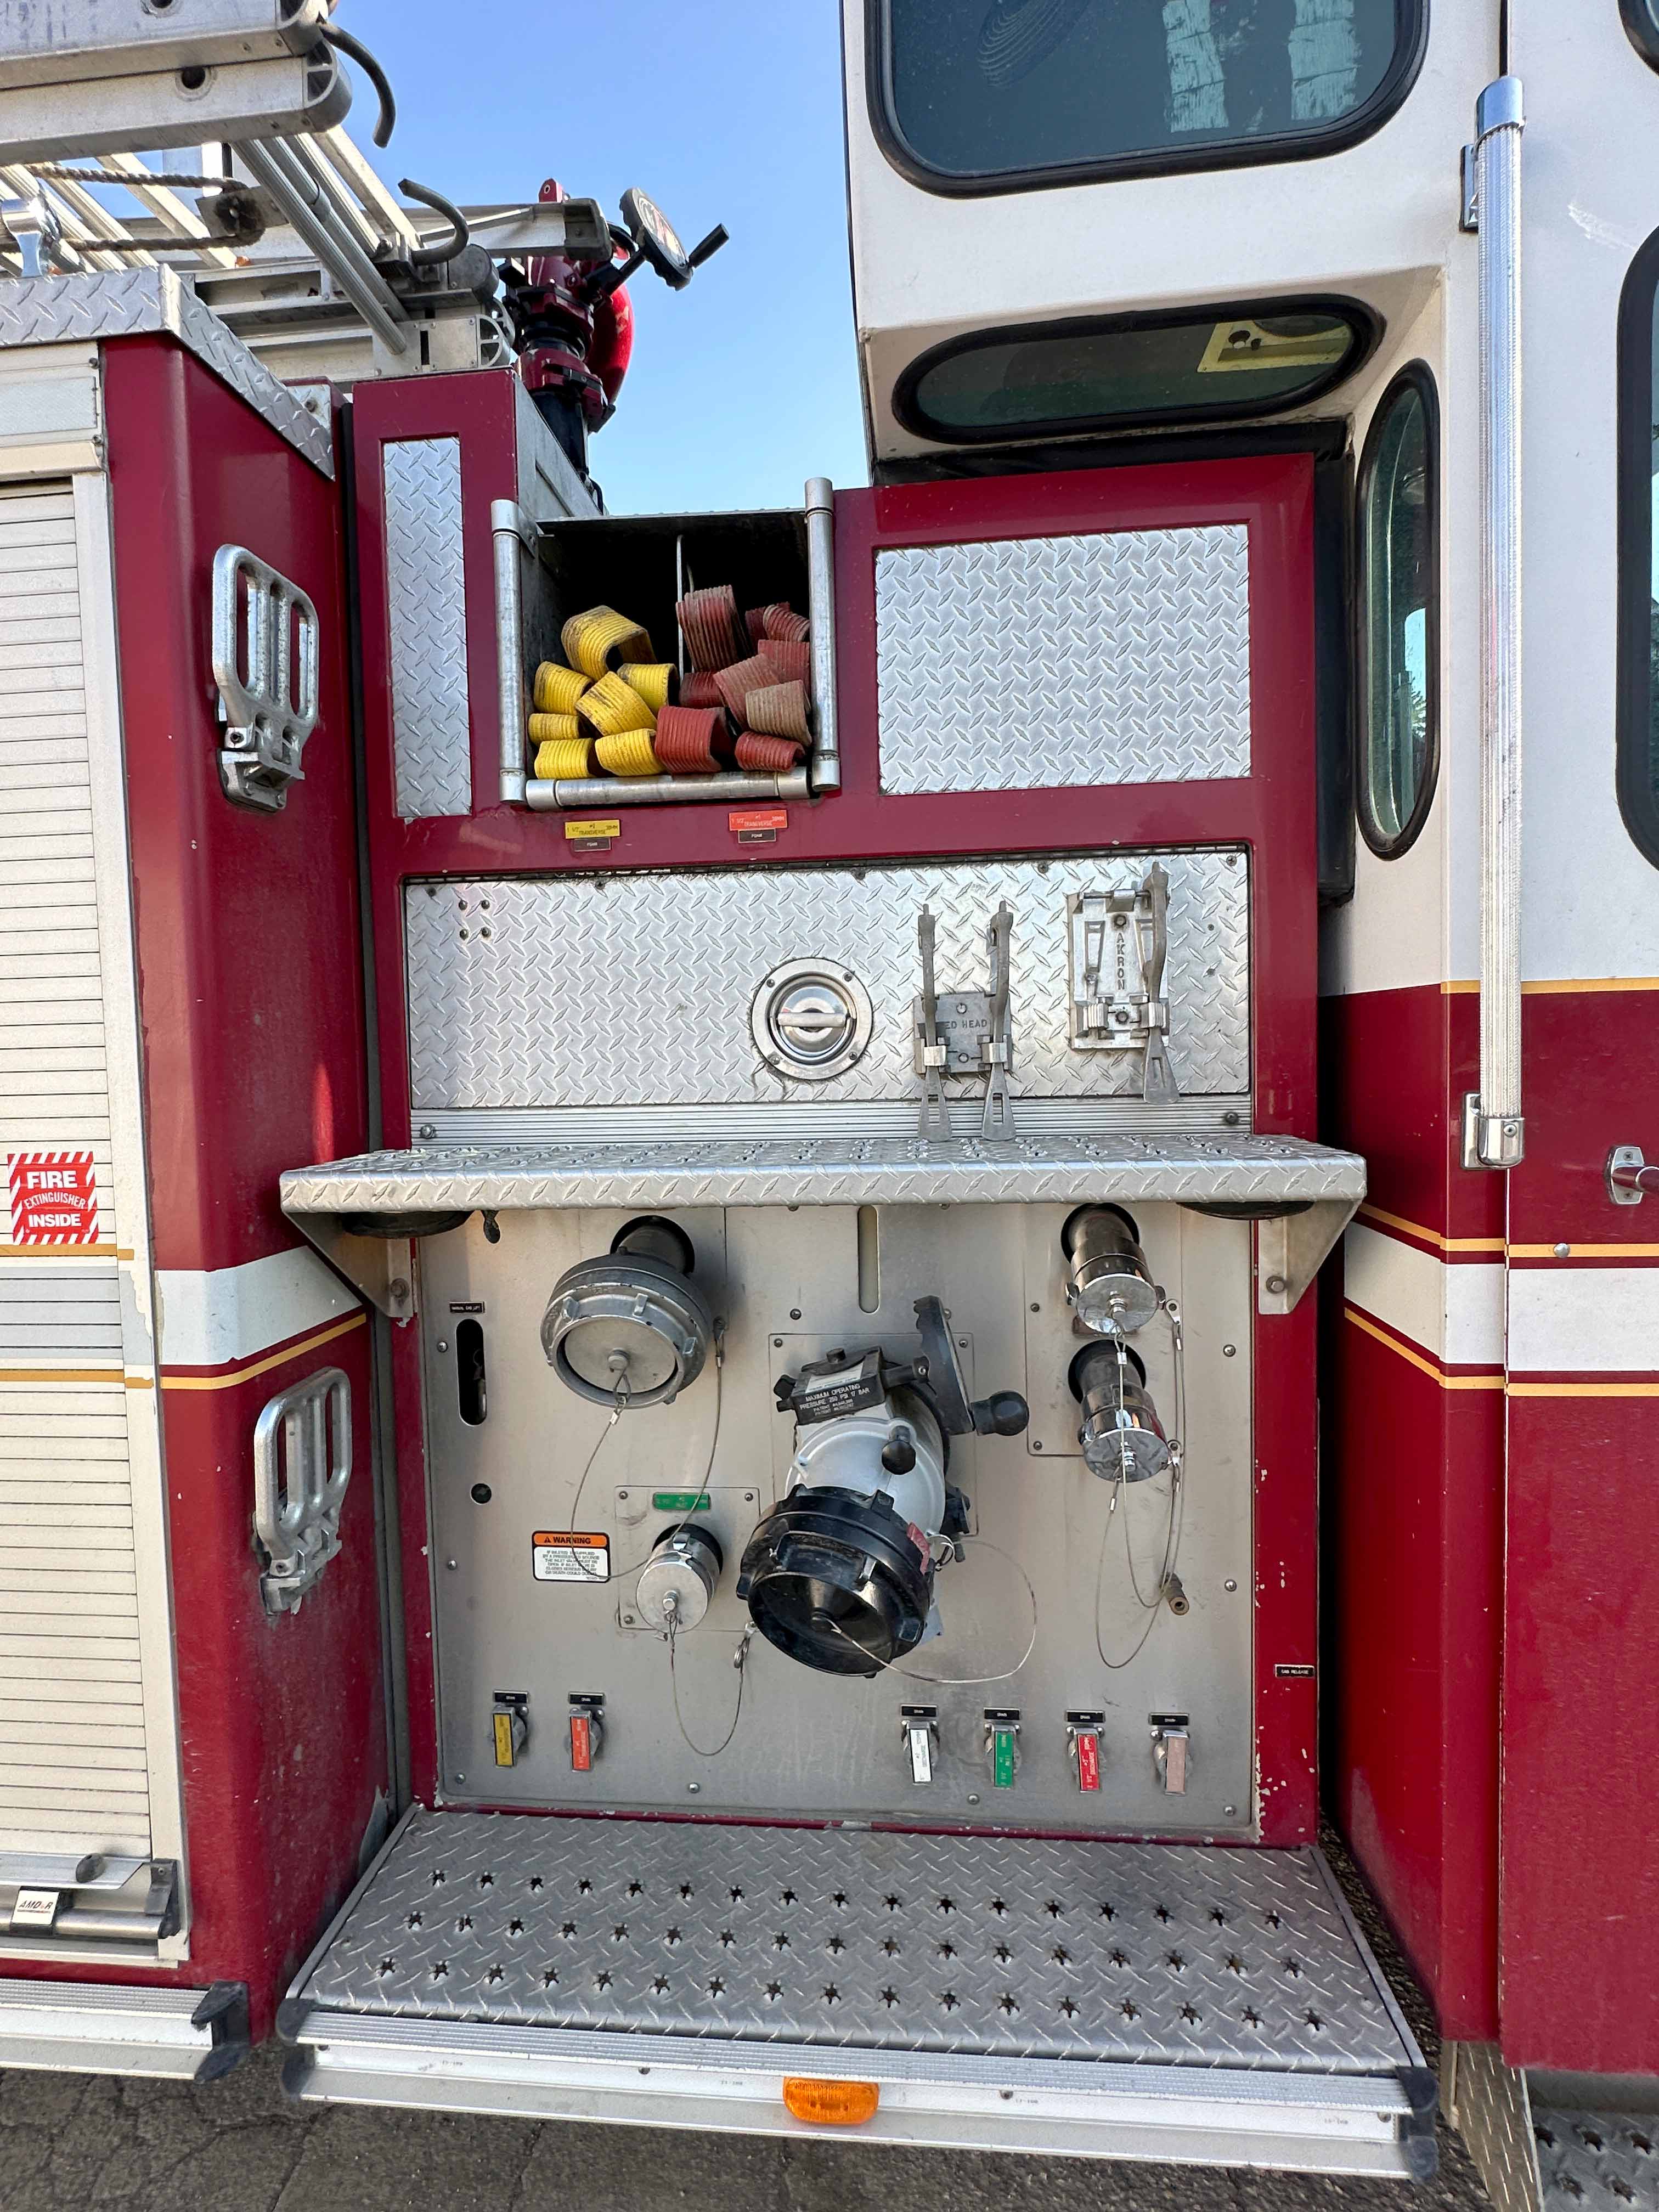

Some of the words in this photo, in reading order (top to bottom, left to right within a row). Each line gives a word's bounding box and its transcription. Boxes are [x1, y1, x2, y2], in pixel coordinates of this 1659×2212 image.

[1117, 932, 1125, 990] AKRON
[945, 1021, 957, 1029] ED
[962, 1019, 988, 1029] HEAD
[26, 1170, 78, 1189] FIRE
[24, 1192, 86, 1210] EXTINGUISHER
[28, 1213, 82, 1228] INSIDE
[805, 1391, 830, 1402] MAXIMUM
[831, 1383, 861, 1396] OPERATING
[799, 1399, 826, 1410] PRESSURE
